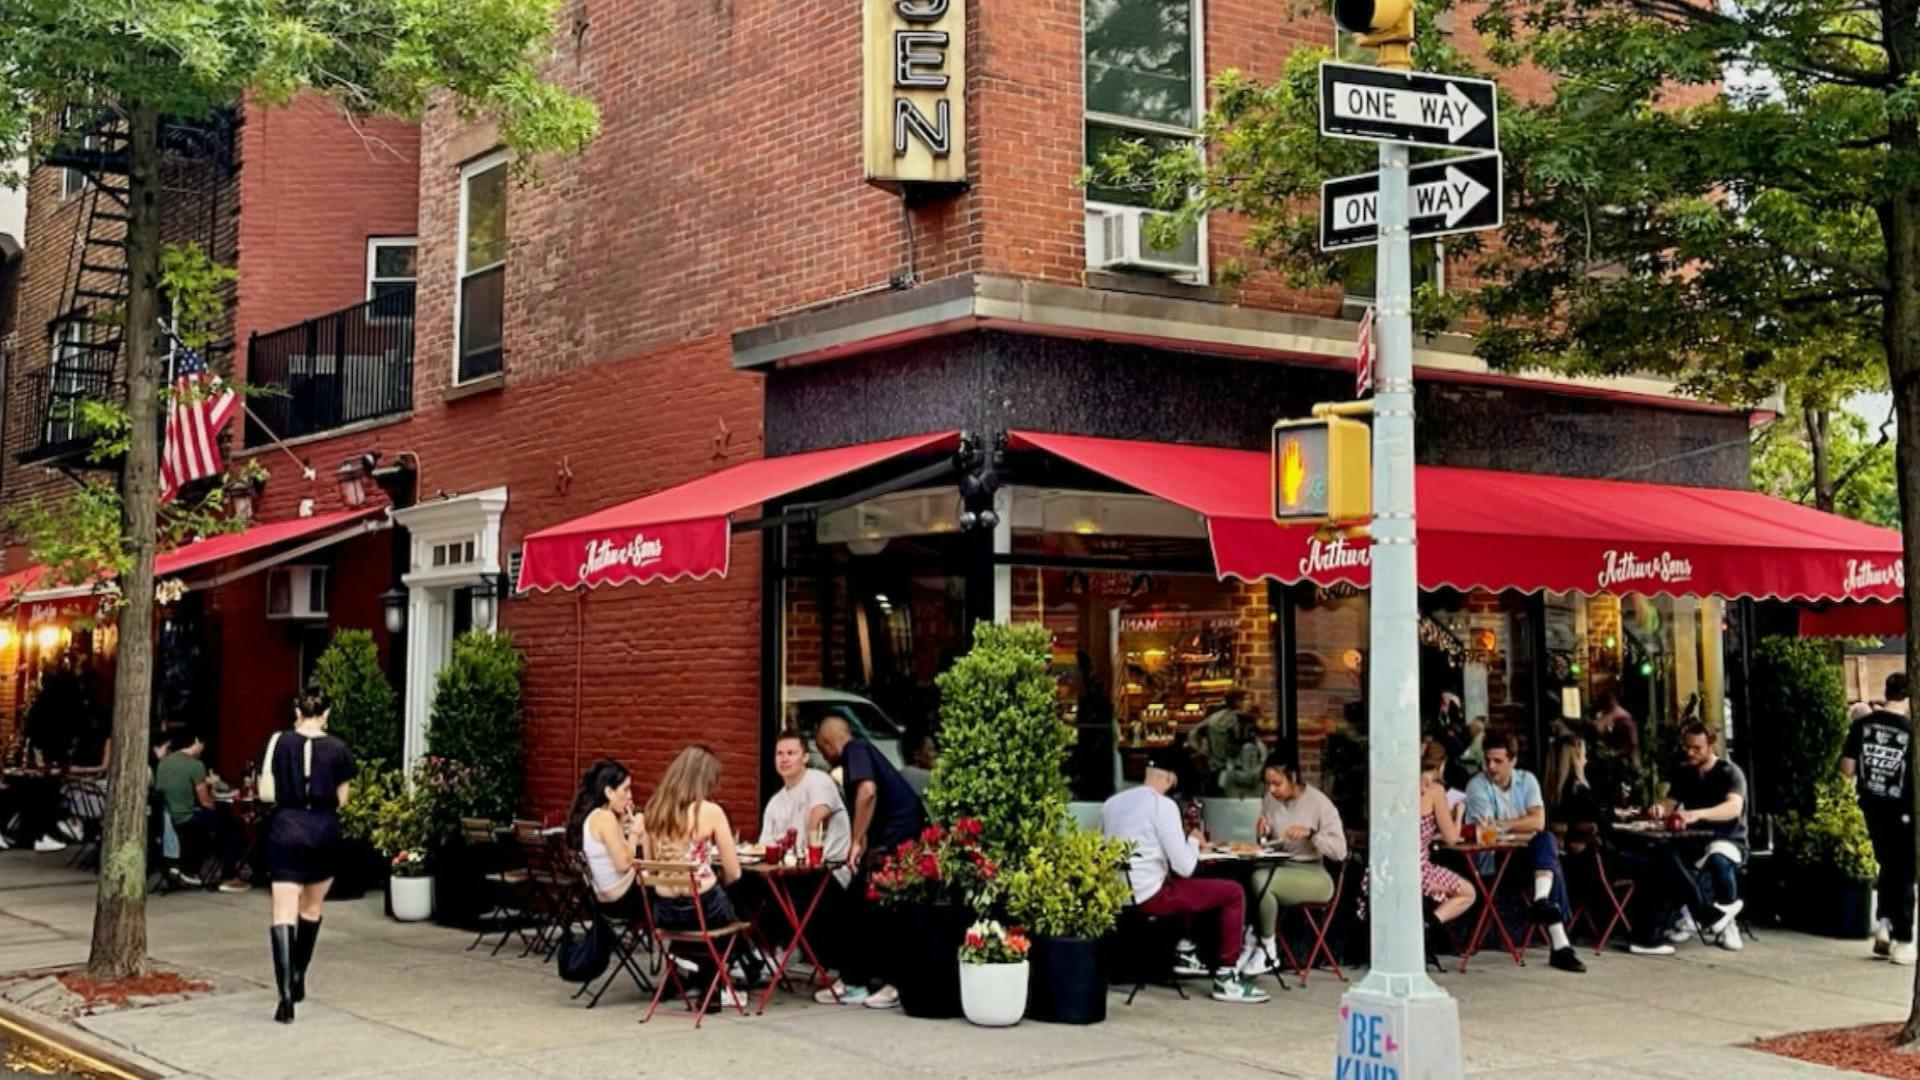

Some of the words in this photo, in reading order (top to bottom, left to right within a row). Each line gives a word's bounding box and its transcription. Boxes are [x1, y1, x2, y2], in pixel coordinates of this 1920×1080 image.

[1349, 89, 1397, 119] ONE
[1420, 96, 1470, 127] WAY
[1346, 196, 1377, 224] ON
[1417, 181, 1470, 214] WAY
[1352, 1012, 1383, 1058] BE
